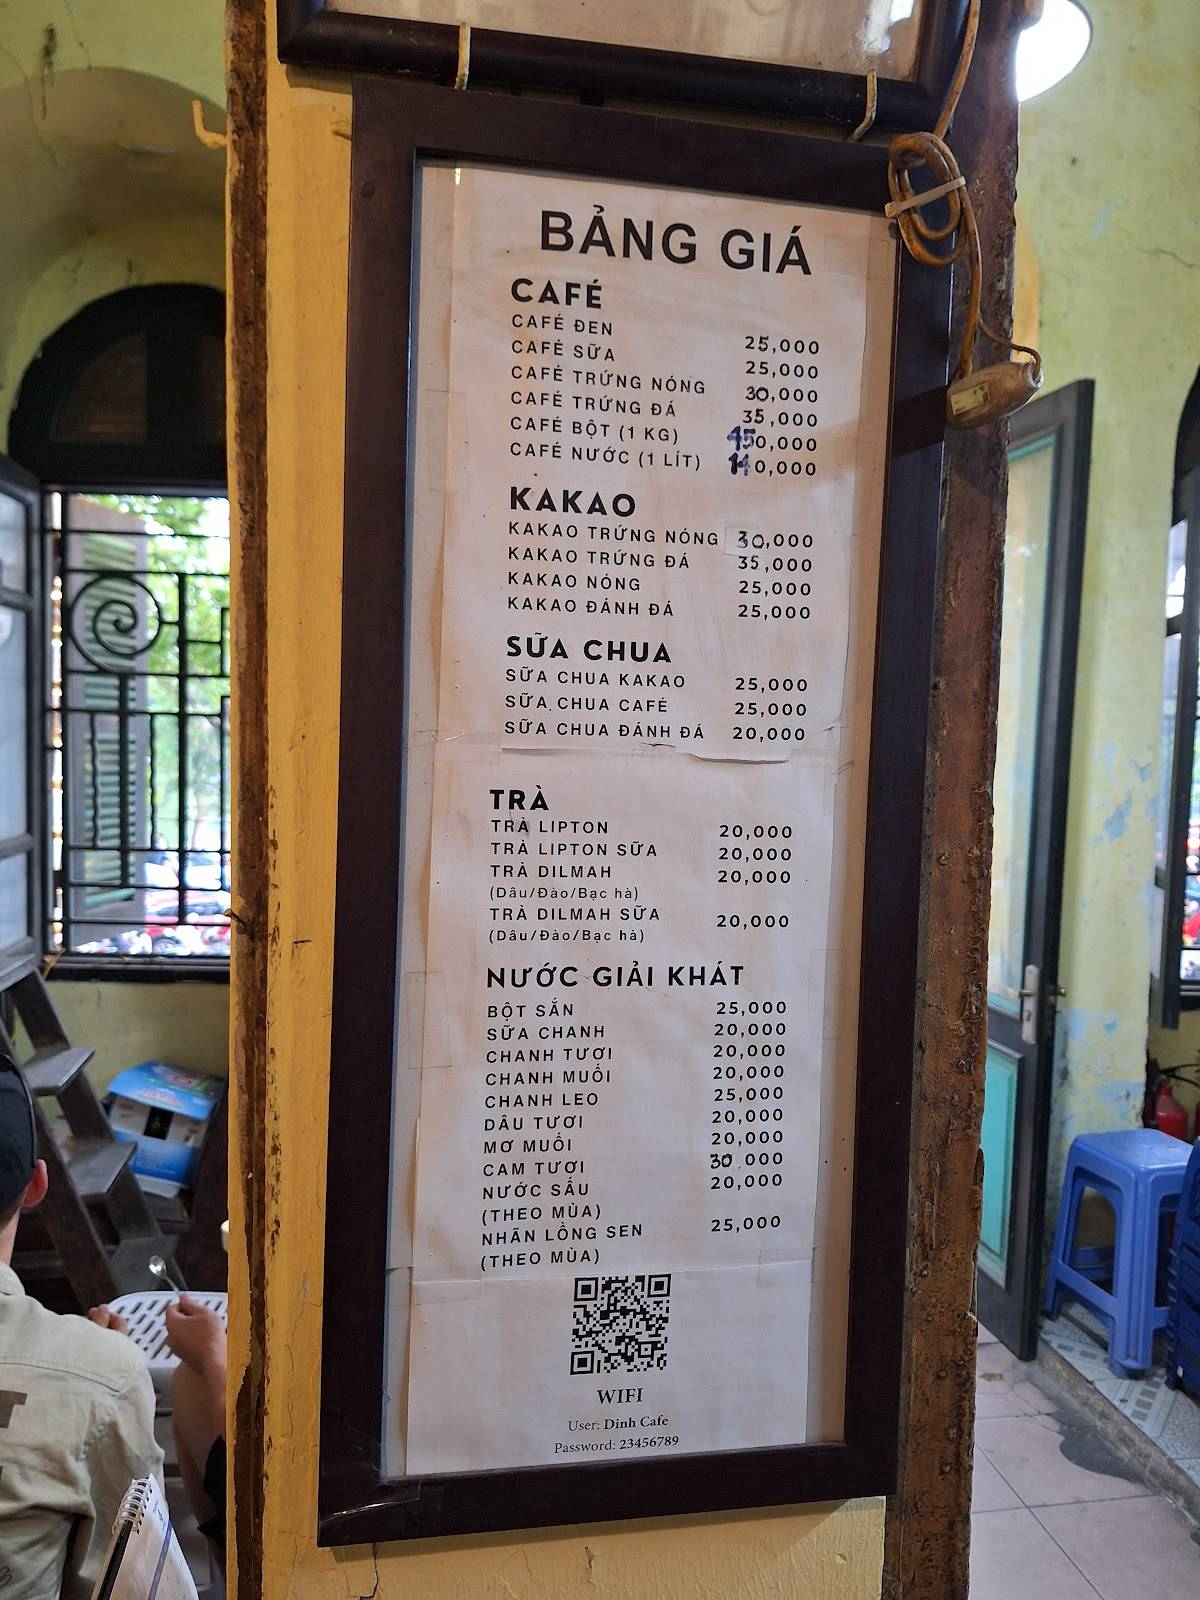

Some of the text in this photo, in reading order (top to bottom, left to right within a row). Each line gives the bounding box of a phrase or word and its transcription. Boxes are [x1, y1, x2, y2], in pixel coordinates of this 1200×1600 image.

[541, 204, 812, 276] BẢNG GIÁ
[511, 278, 602, 309] CAFÉ
[512, 313, 612, 336] CAFÉ ĐEN
[512, 339, 615, 362] CAFÉ SỮA
[745, 335, 819, 355] 25,000
[746, 360, 818, 379] 25,000
[511, 364, 705, 394] CAFÉ TRỨNG NÓNG
[511, 390, 675, 417] CAFÉ TRỨNG ĐÁ
[745, 386, 818, 403] 30,000
[742, 408, 817, 428] 35,000
[510, 416, 678, 445] CAFÉ BỘT (1 KG)
[510, 441, 700, 472] CAFÉ NƯỚC (1 LÍT)
[510, 486, 635, 517] KAKAO
[509, 521, 718, 546] KAKAO TRỨNG NÓNG
[737, 530, 813, 549] 30,000
[508, 546, 689, 569] KAKAO TRỨNG ĐÁ
[738, 555, 812, 573] 35,000
[508, 571, 640, 591] KAKAO NÓNG
[739, 580, 811, 597] 25,000
[508, 596, 673, 616] KAKAO ĐÁNH ĐÁ
[738, 604, 810, 621] 25,000
[506, 632, 672, 663] SỮA CHUA
[506, 666, 685, 688] SỮA CHUA KAKAO
[735, 677, 807, 693] 25,000
[505, 692, 667, 712] SỮA CHUA CAFÉ
[734, 702, 806, 718] 25,000
[505, 718, 704, 739] SỮA CHUA ĐÁNH ĐÁ
[733, 727, 805, 743] 20,000
[489, 785, 549, 811] TRÀ
[491, 817, 608, 835] TRÀ LIPTON
[719, 824, 792, 840] 20,000
[491, 839, 657, 856] TRÀ LIPTON SỮA
[718, 847, 791, 863] 20,000
[490, 861, 611, 878] TRÀ DILMAH
[718, 870, 791, 886] 20,000
[615, 886, 638, 902] hà)
[489, 904, 659, 921] TRÀ DILMAH SỮA
[717, 914, 789, 930] 20,000
[619, 929, 644, 943] hà)
[487, 960, 744, 989] NƯỚC GIẢI KHÁT
[488, 997, 573, 1021] BỘT SẮN
[716, 1001, 786, 1017] 25,000
[487, 1024, 604, 1041] SỮA CHANH
[714, 1023, 786, 1038] 20,000
[486, 1047, 611, 1063] CHANH TƯƠI
[713, 1044, 785, 1060] 20,000
[486, 1063, 610, 1086] CHANH MUỐI
[713, 1065, 784, 1082] 20,000
[485, 1092, 598, 1109] CHANH LEO
[714, 1086, 783, 1103] 25,000
[484, 1114, 582, 1131] DÂU TƯƠI
[712, 1108, 783, 1125] 20,000
[484, 1132, 571, 1154] MƠ MUỐI
[712, 1130, 783, 1147] 20,000
[483, 1160, 584, 1177] CAM TƯƠI
[483, 1176, 588, 1200] NƯỚC SẤU
[711, 1173, 782, 1191] 20,000
[482, 1202, 600, 1226] (THEO MÙA)
[482, 1221, 642, 1246] NHÃN LỒNG SEN
[711, 1216, 781, 1233] 25,000
[481, 1247, 599, 1272] (THEO MÙA)
[597, 1388, 644, 1404] WIFI
[568, 1414, 668, 1431] User: Dinh Cafe
[554, 1436, 679, 1453] Password: 23456789
